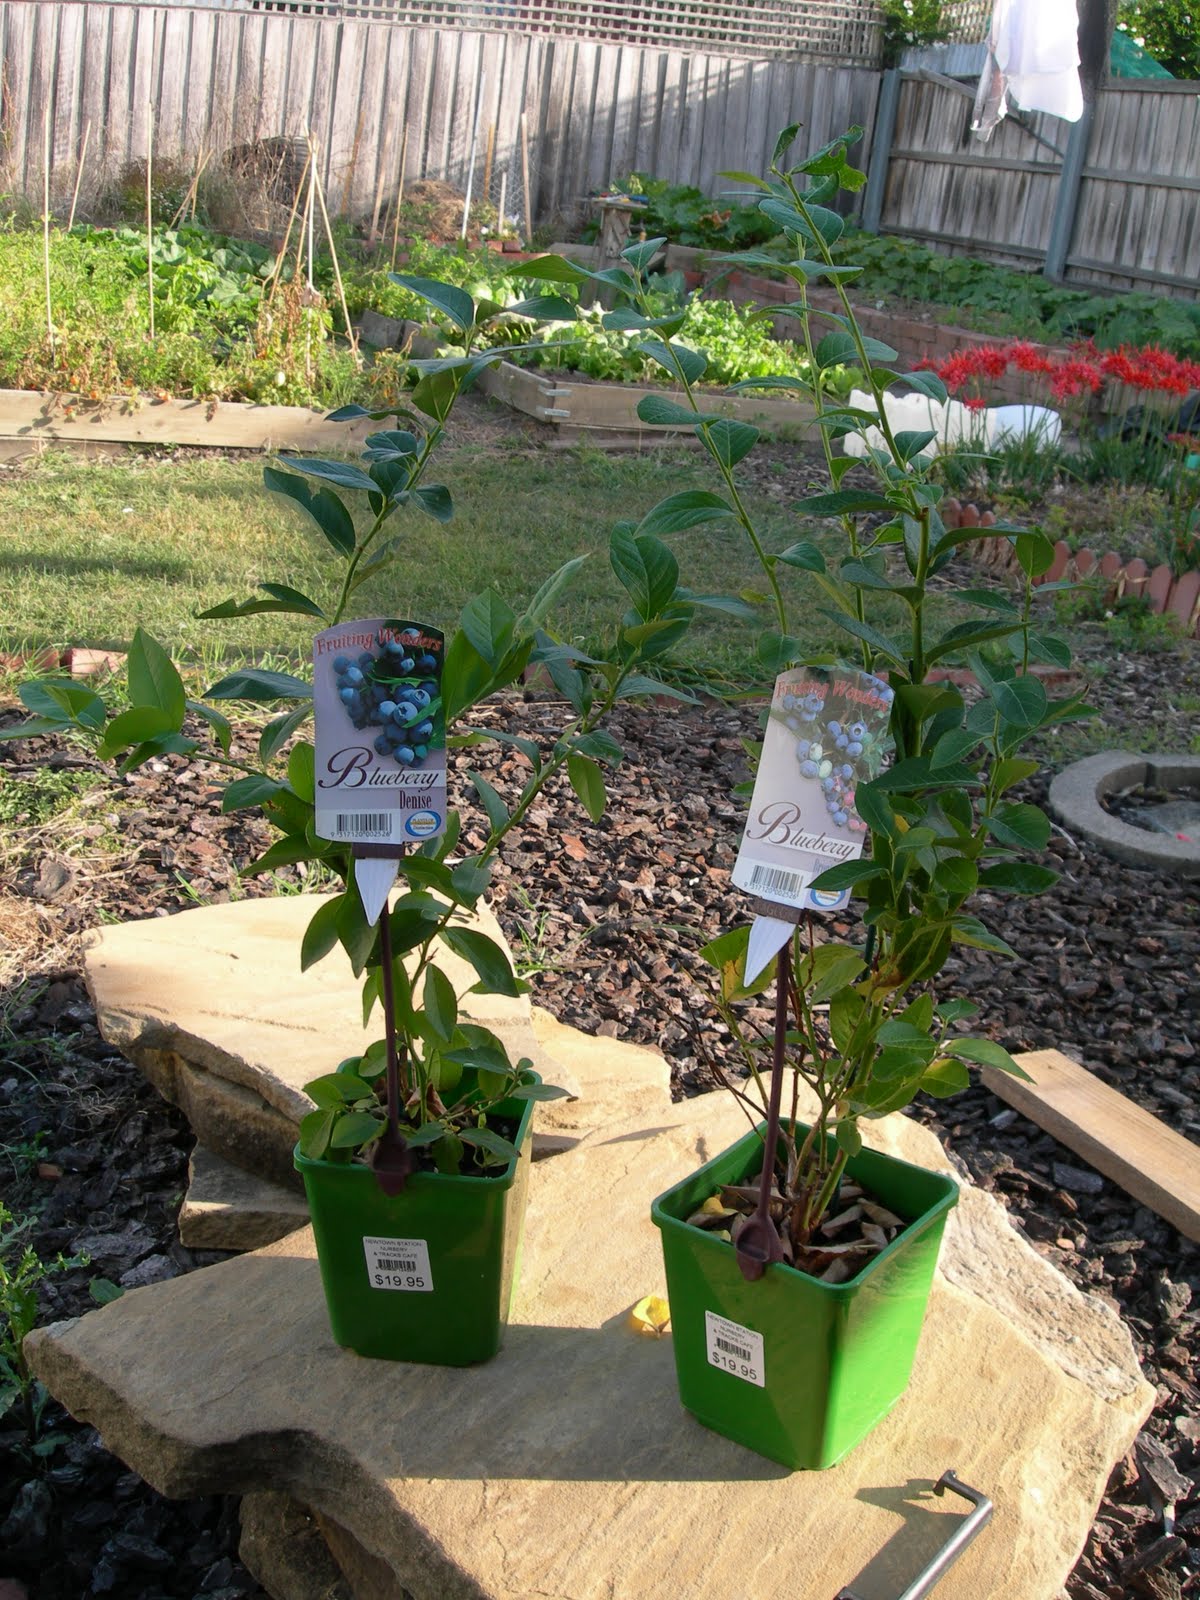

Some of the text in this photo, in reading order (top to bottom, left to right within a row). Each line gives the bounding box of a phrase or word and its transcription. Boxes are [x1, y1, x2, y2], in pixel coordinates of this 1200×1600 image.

[317, 626, 442, 656] Fruiting Wonders
[775, 680, 830, 700] Fruiting
[317, 746, 439, 791] Blueberry
[400, 789, 432, 809] Denise
[746, 801, 856, 862] Blueberry
[374, 1273, 425, 1288] $19.95
[712, 1351, 758, 1380] $19.95
